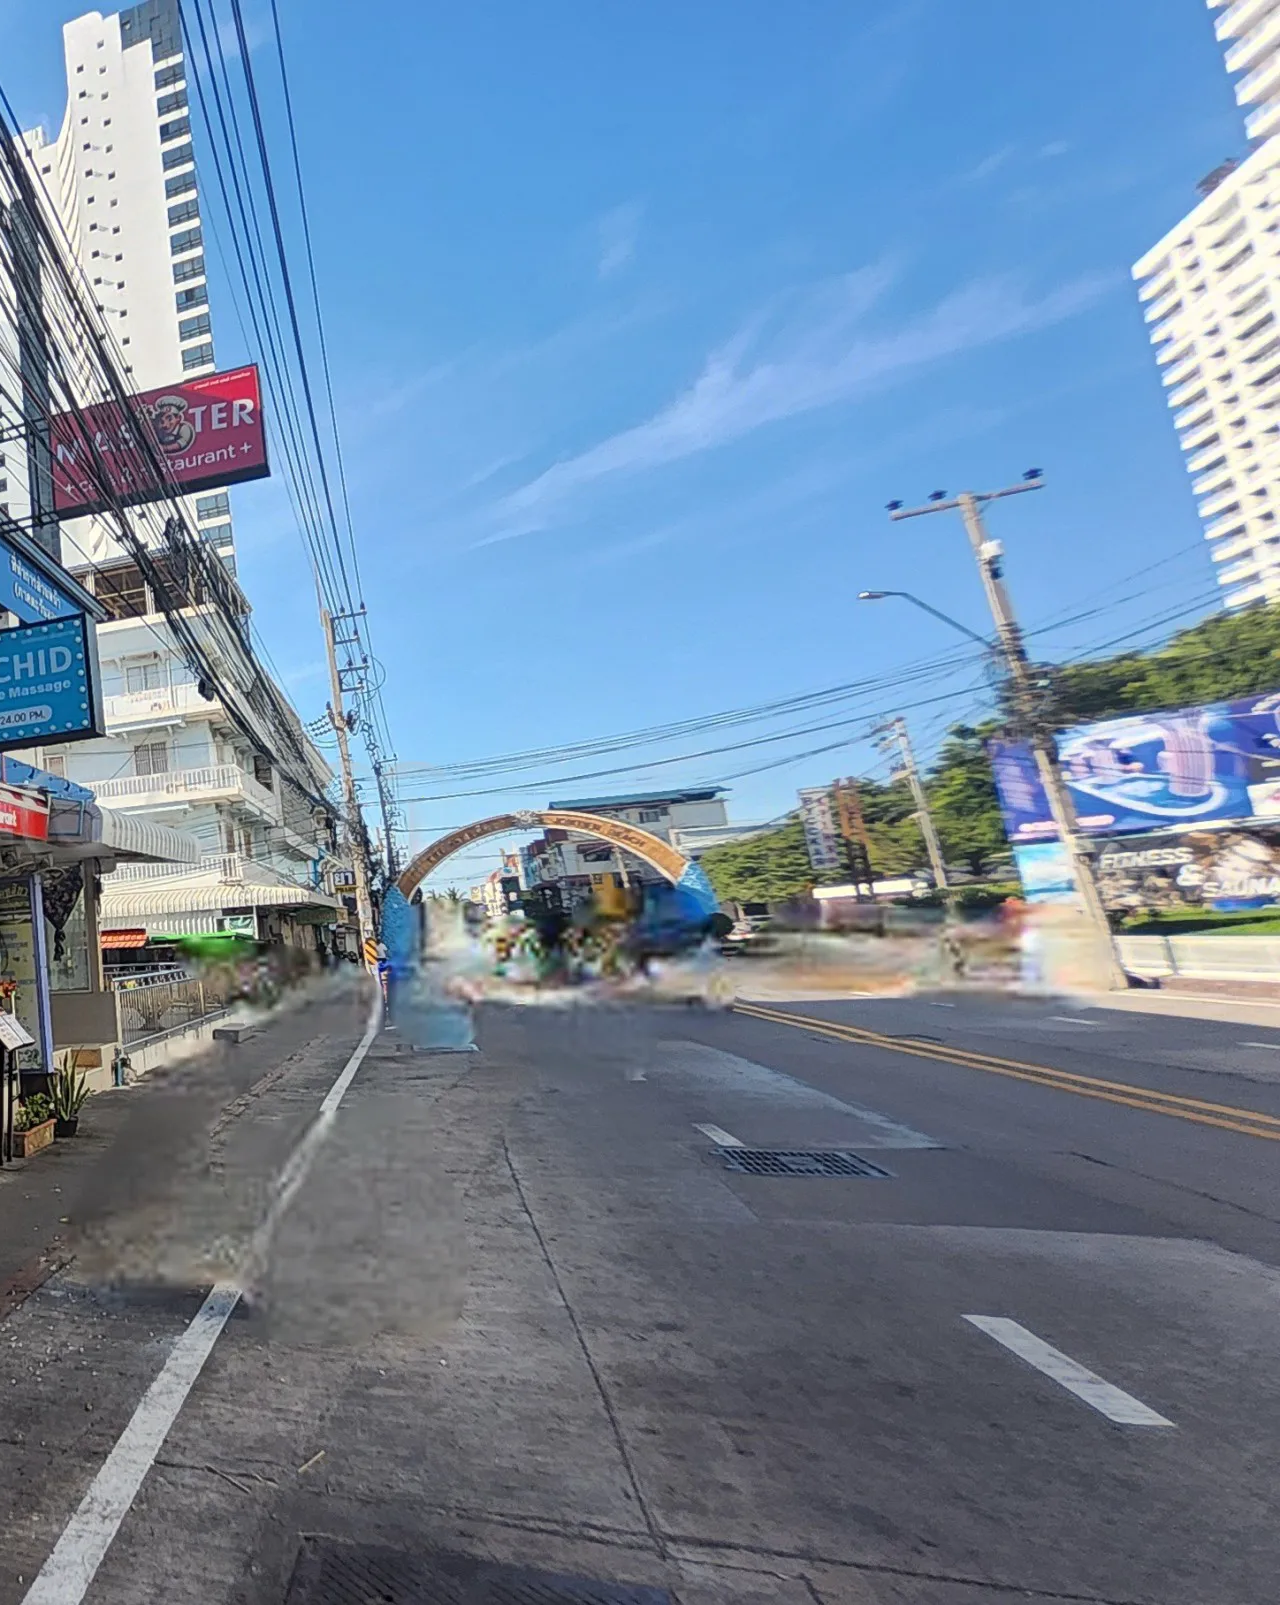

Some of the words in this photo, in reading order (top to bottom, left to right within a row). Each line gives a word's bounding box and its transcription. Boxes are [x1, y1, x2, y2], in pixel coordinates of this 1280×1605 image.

[9, 679, 71, 699] Massage
[0, 712, 26, 726] 24.00
[1099, 847, 1194, 869] FITNESS
